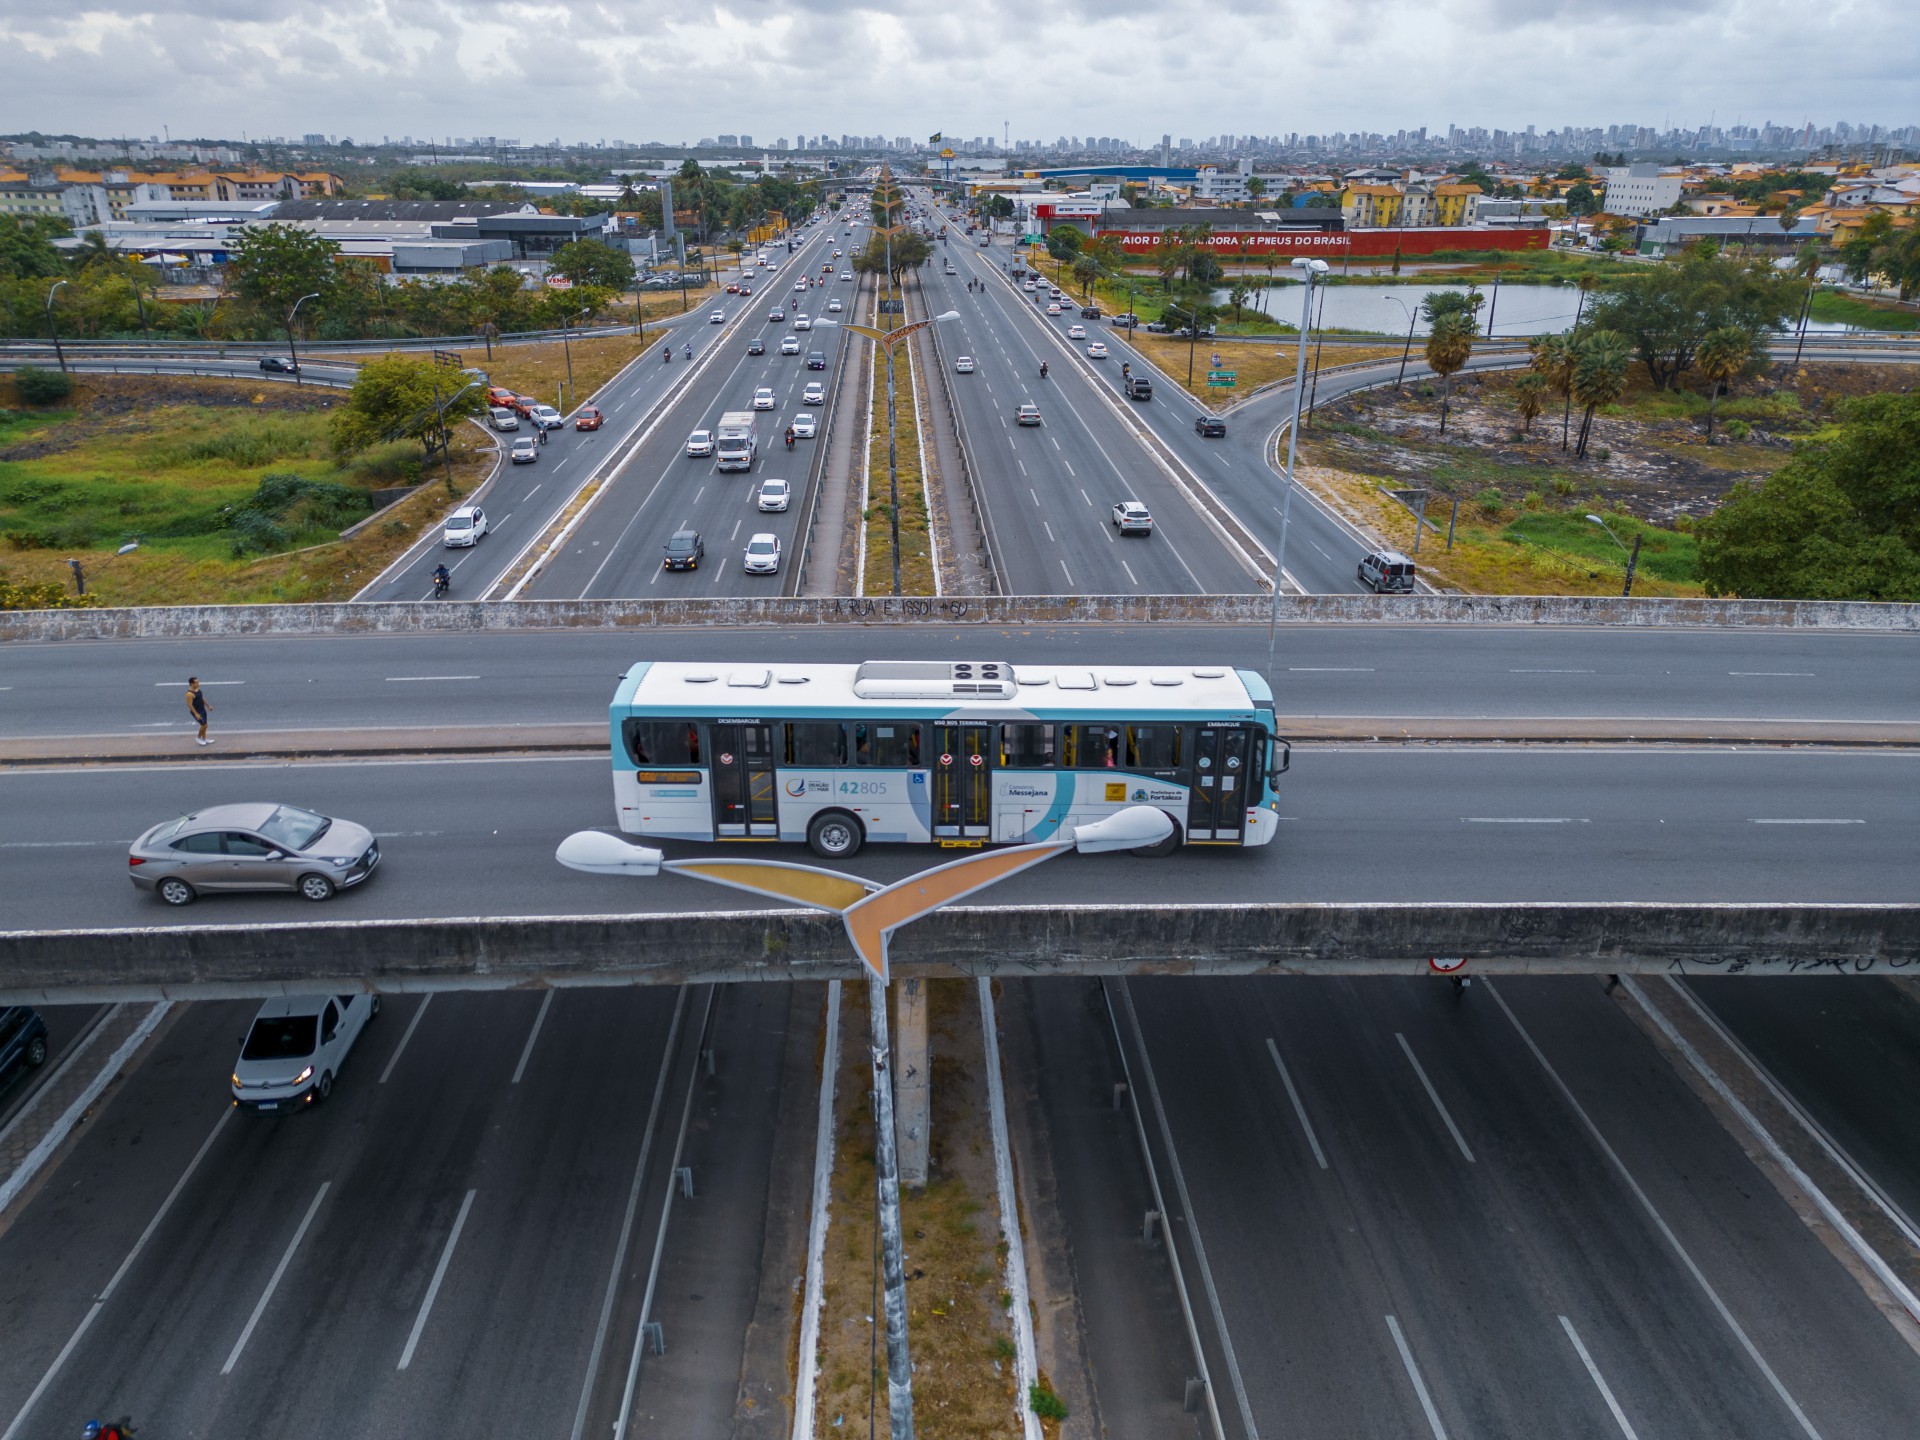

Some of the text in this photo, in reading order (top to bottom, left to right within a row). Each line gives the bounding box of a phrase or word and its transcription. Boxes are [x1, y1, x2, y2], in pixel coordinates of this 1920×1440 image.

[1111, 236, 1150, 245] AIOR
[1257, 236, 1292, 245] PNEUS
[1294, 236, 1312, 245] DO
[1313, 236, 1351, 245] BRASIL
[846, 598, 876, 616] RUA
[839, 781, 887, 795] 42805
[1008, 789, 1048, 797] Messejana
